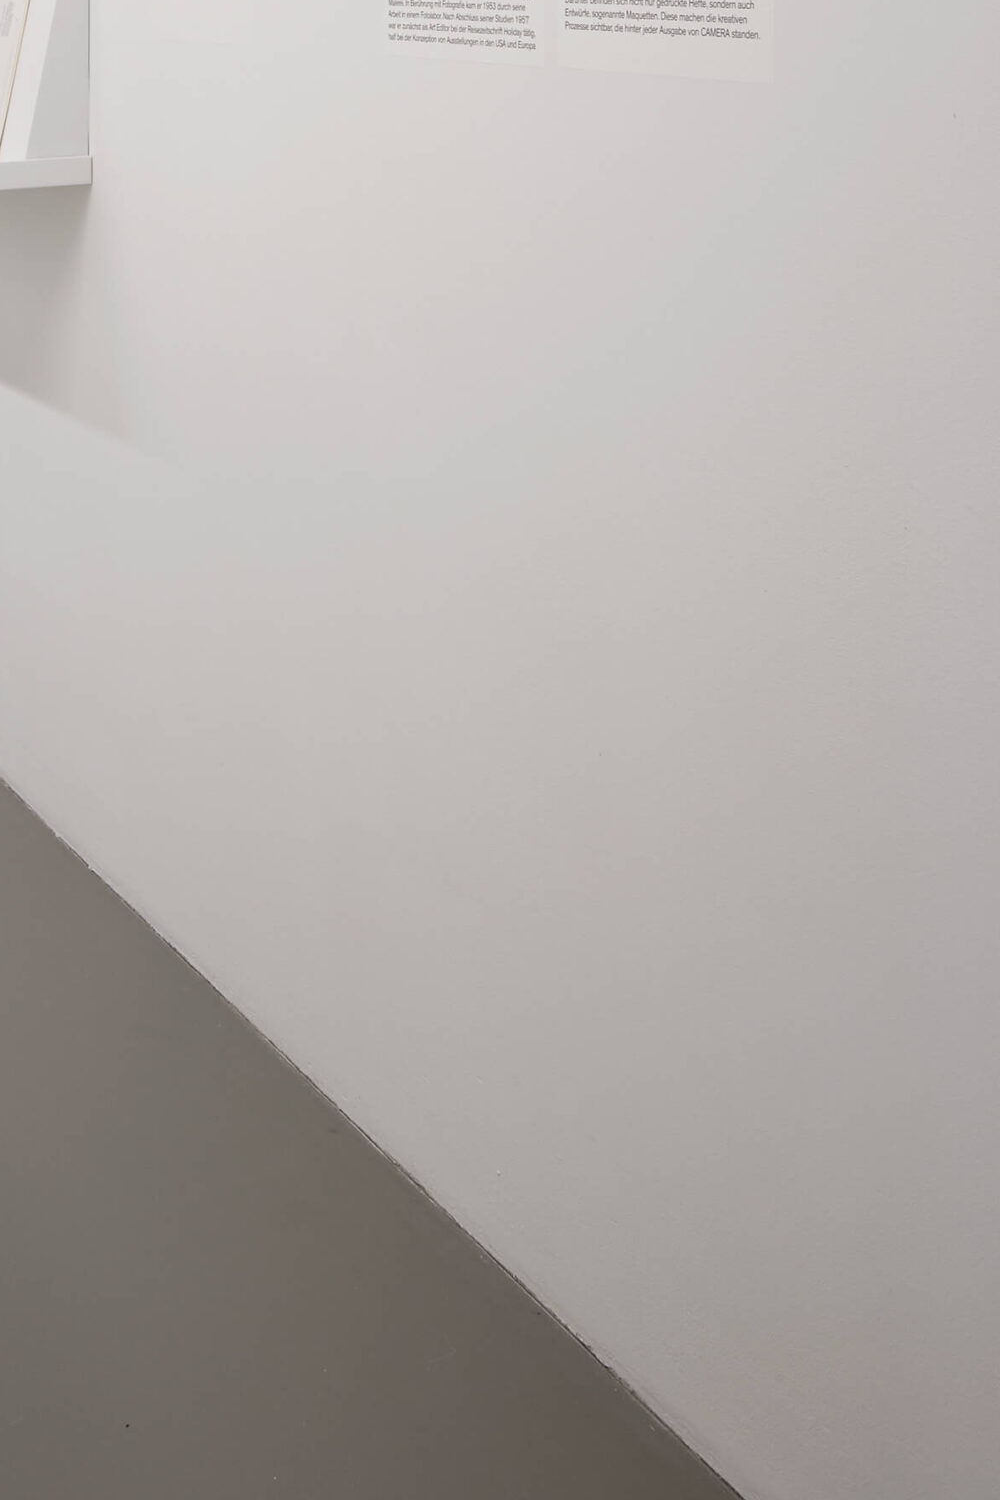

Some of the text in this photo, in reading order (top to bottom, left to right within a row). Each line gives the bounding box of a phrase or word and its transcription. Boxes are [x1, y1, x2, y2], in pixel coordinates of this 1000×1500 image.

[709, 0, 736, 8] sondern
[738, 0, 754, 9] auch
[660, 12, 678, 21] Diese
[679, 13, 705, 22] machen
[706, 13, 716, 22] die
[717, 14, 747, 23] kreativen
[659, 26, 686, 37] Ausgabe
[700, 28, 731, 37] CAMERA
[732, 29, 760, 39] standen.
